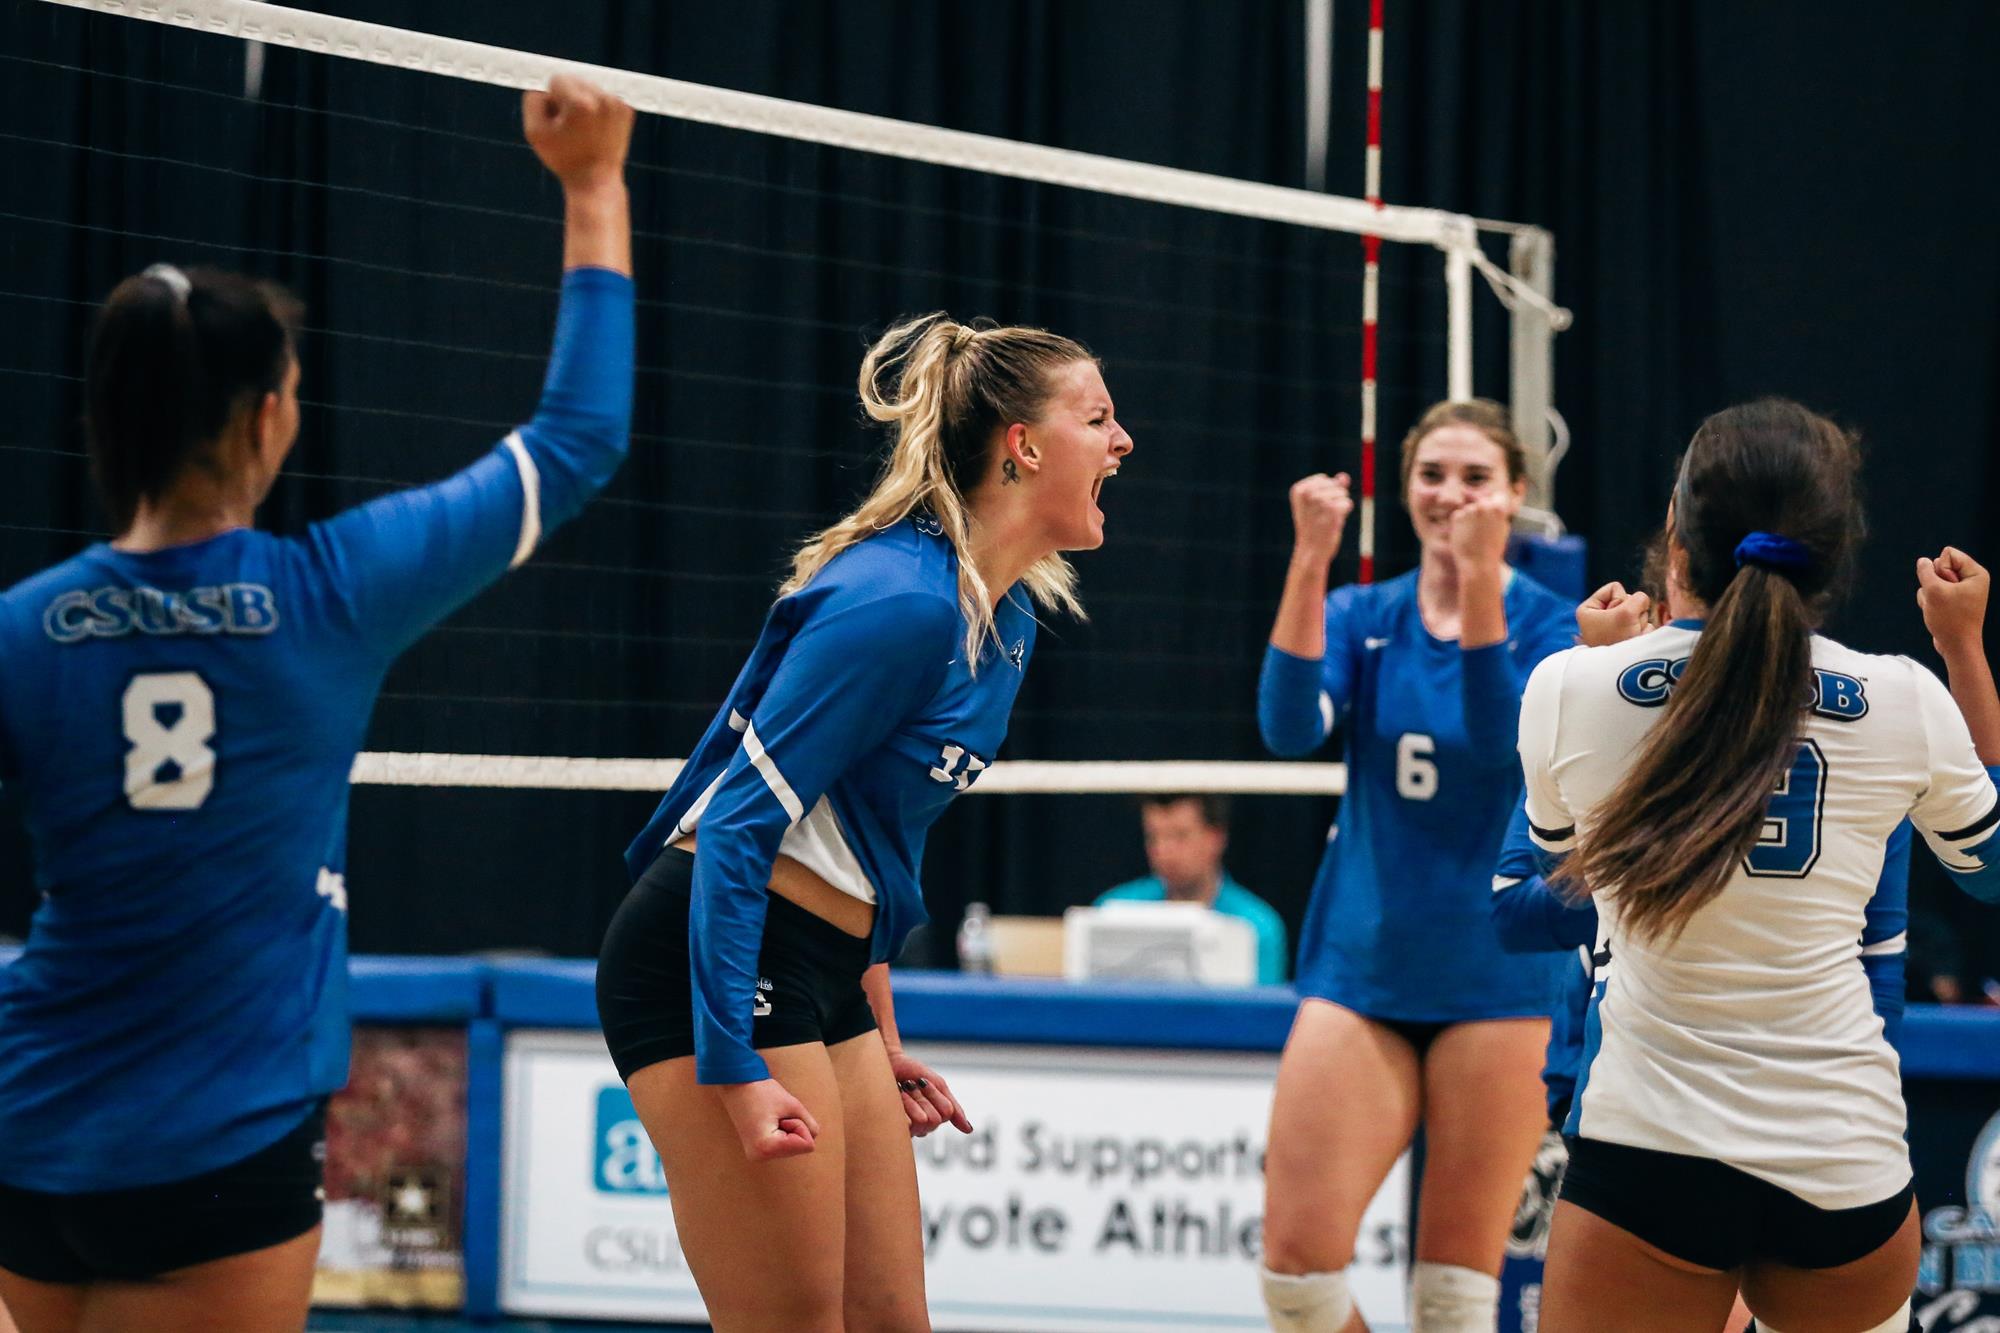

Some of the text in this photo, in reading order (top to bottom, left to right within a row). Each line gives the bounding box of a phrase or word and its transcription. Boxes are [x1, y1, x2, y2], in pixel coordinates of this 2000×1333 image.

[43, 582, 279, 643] CSUSB
[122, 671, 216, 810] 8
[1396, 732, 1439, 801] 6
[915, 1119, 1266, 1186] ud Support
[923, 1191, 1068, 1261] yote
